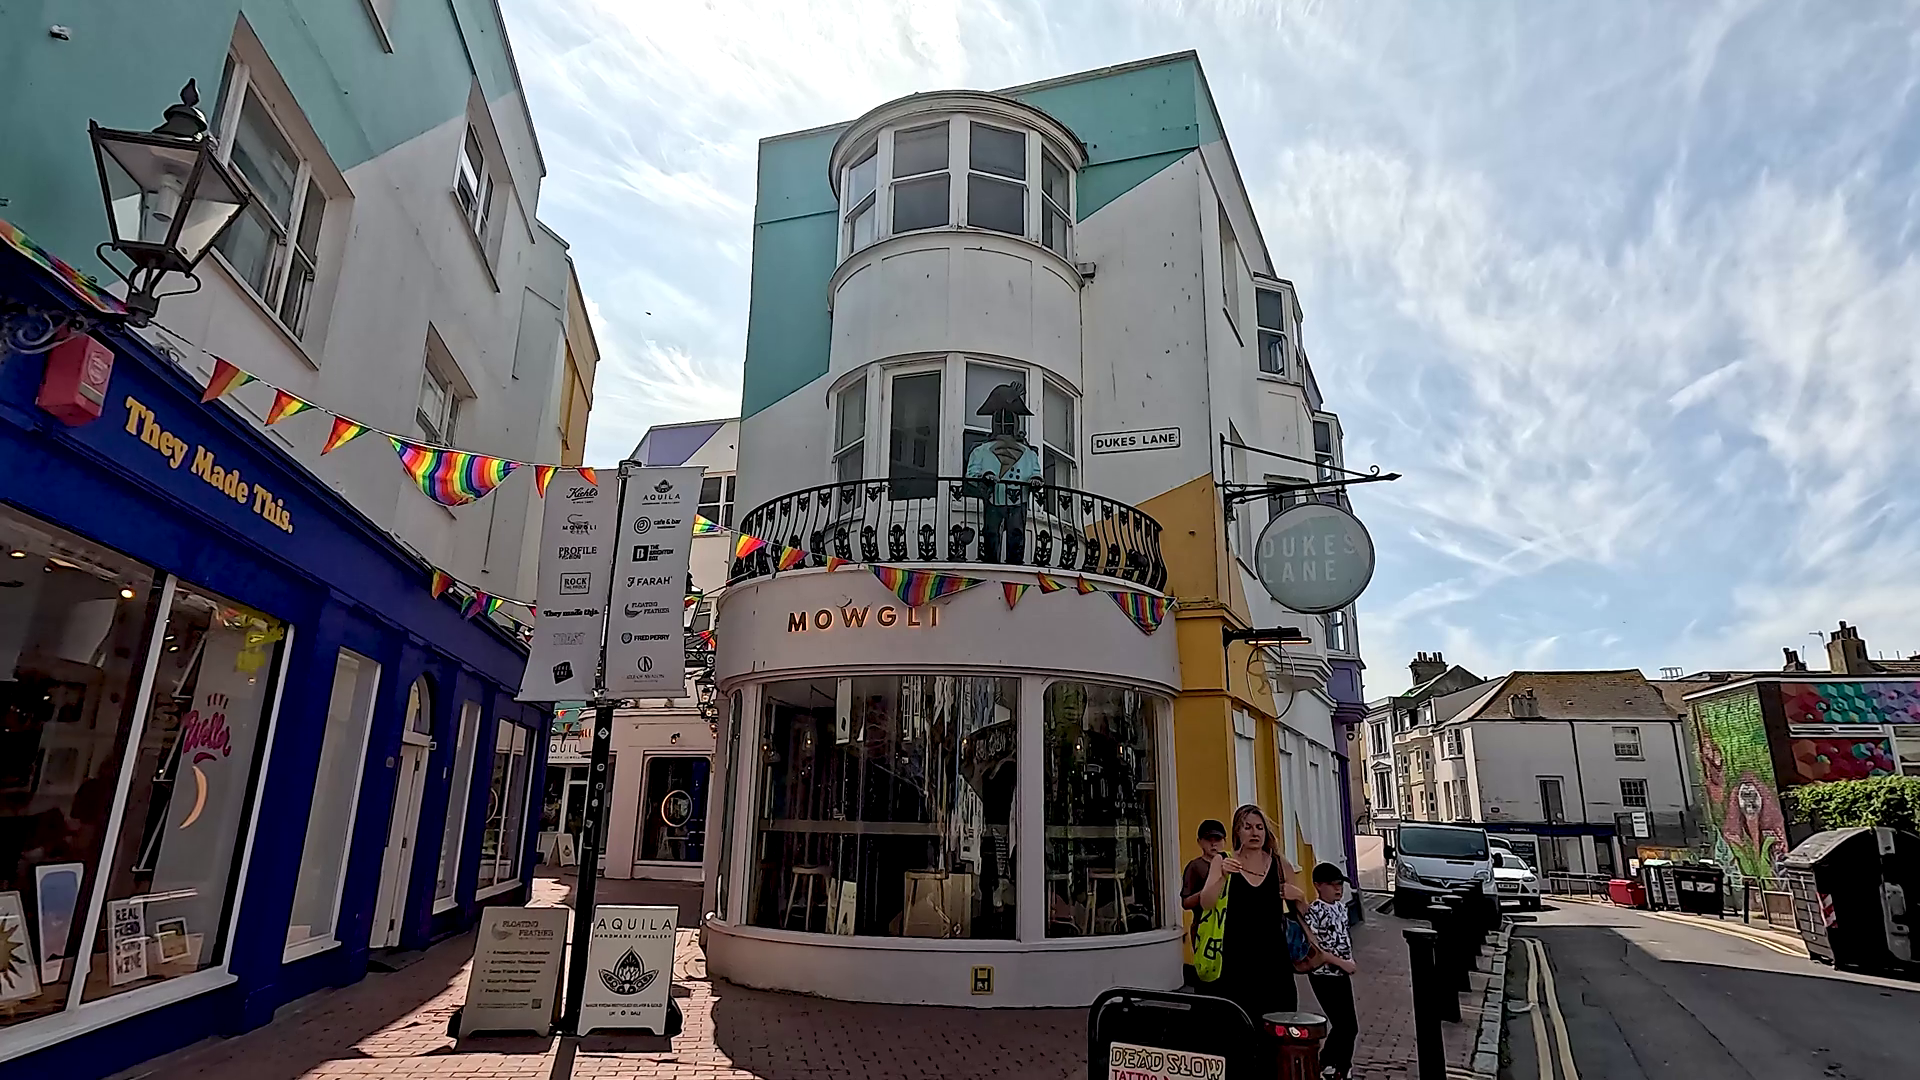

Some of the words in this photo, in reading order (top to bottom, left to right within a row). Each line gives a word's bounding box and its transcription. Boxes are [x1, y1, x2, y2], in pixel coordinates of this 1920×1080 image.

[1096, 436, 1136, 448] DUKES
[1142, 433, 1176, 444] LANE
[126, 396, 188, 469] They
[191, 445, 249, 503] Made
[253, 484, 293, 533] This.
[643, 493, 681, 501] AQUILA
[558, 546, 598, 555] PROFILE
[1262, 533, 1356, 558] DUKES
[1263, 560, 1337, 583] LANE
[564, 577, 588, 586] ROCK
[636, 576, 672, 587] FARAH
[787, 605, 938, 633] MOWGLI
[649, 633, 670, 641] PERRY
[596, 917, 672, 931] AQUILA
[1110, 1046, 1164, 1073] DEAD
[1166, 1053, 1224, 1080] SLOW
